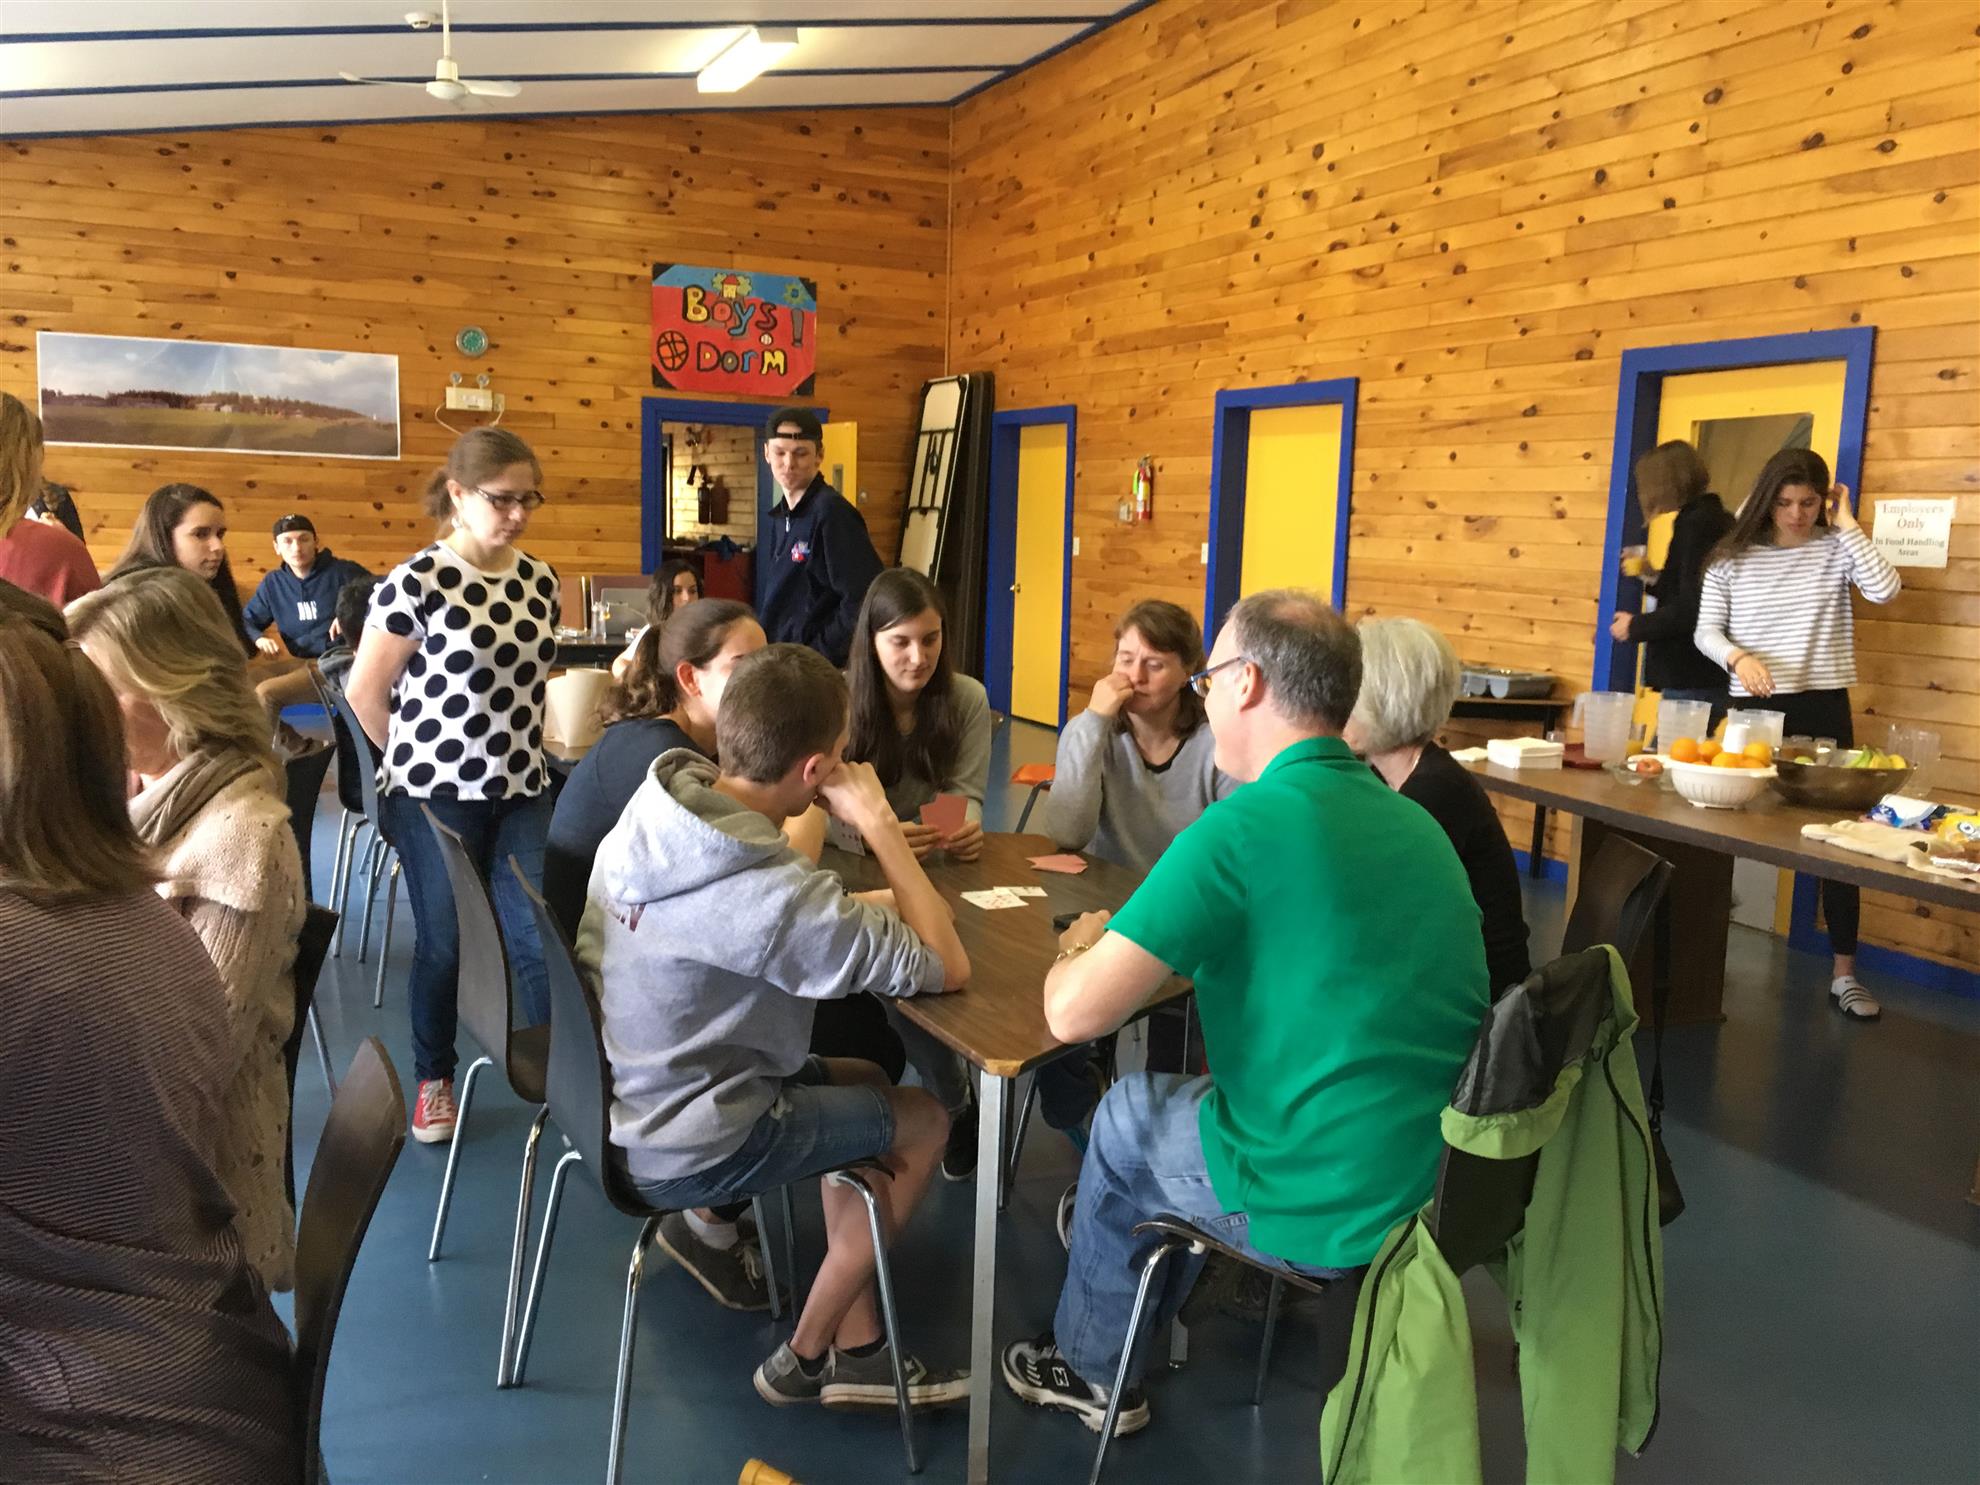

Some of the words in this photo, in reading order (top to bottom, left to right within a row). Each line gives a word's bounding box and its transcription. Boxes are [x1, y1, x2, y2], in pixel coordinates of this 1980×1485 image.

[1897, 517, 1926, 531] Only
[1885, 537, 1905, 546] Food
[1907, 537, 1945, 548] Handling
[1898, 548, 1919, 556] Areas
